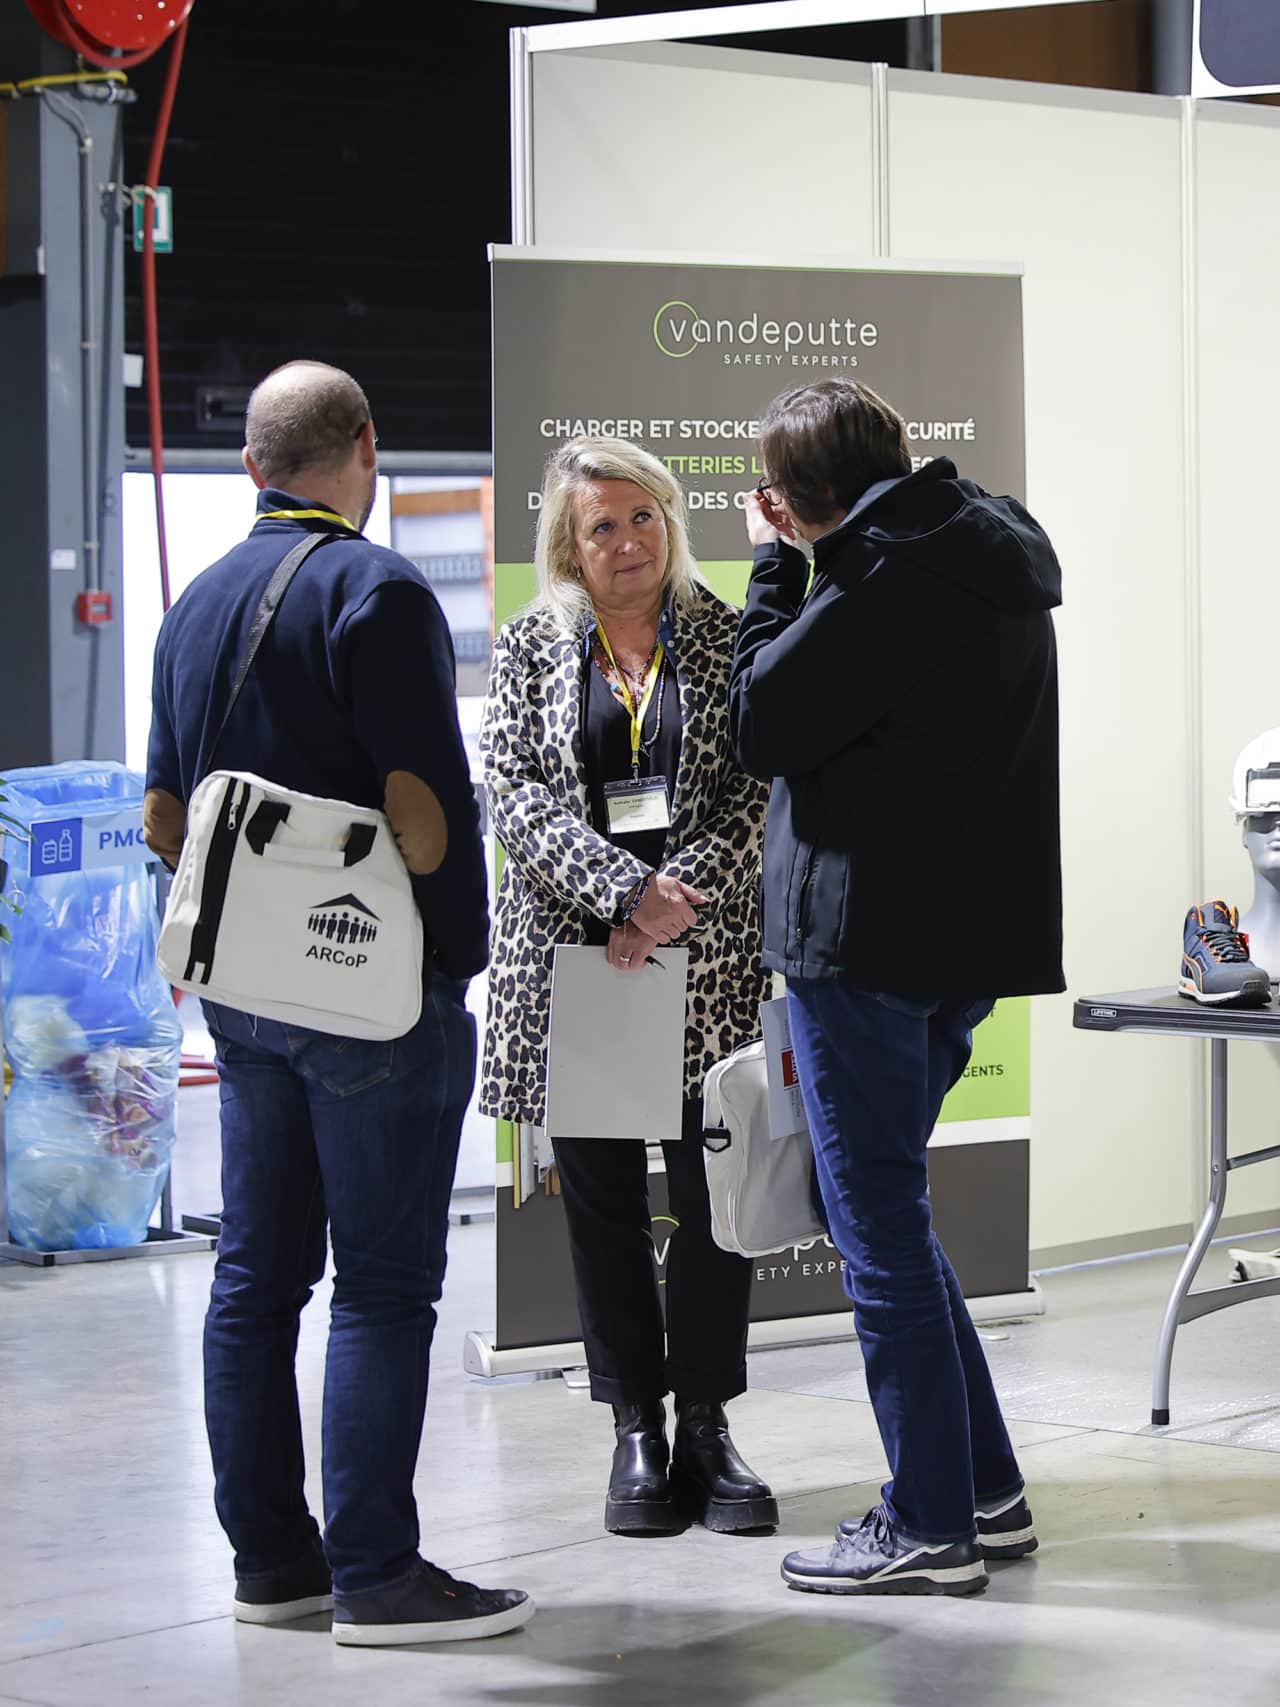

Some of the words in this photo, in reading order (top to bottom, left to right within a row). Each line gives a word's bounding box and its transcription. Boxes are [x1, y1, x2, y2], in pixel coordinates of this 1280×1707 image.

[668, 312, 878, 353] vandeputte
[723, 353, 783, 366] SAFETY
[791, 355, 859, 367] EXPERTS
[540, 418, 644, 438] CHARGER
[649, 420, 675, 438] ET
[679, 420, 760, 439] STOCKE
[902, 417, 976, 441] CURITÉ
[655, 455, 745, 474] TTERIES
[305, 944, 368, 968] ARCoP
[802, 1259, 848, 1276] EXPE
